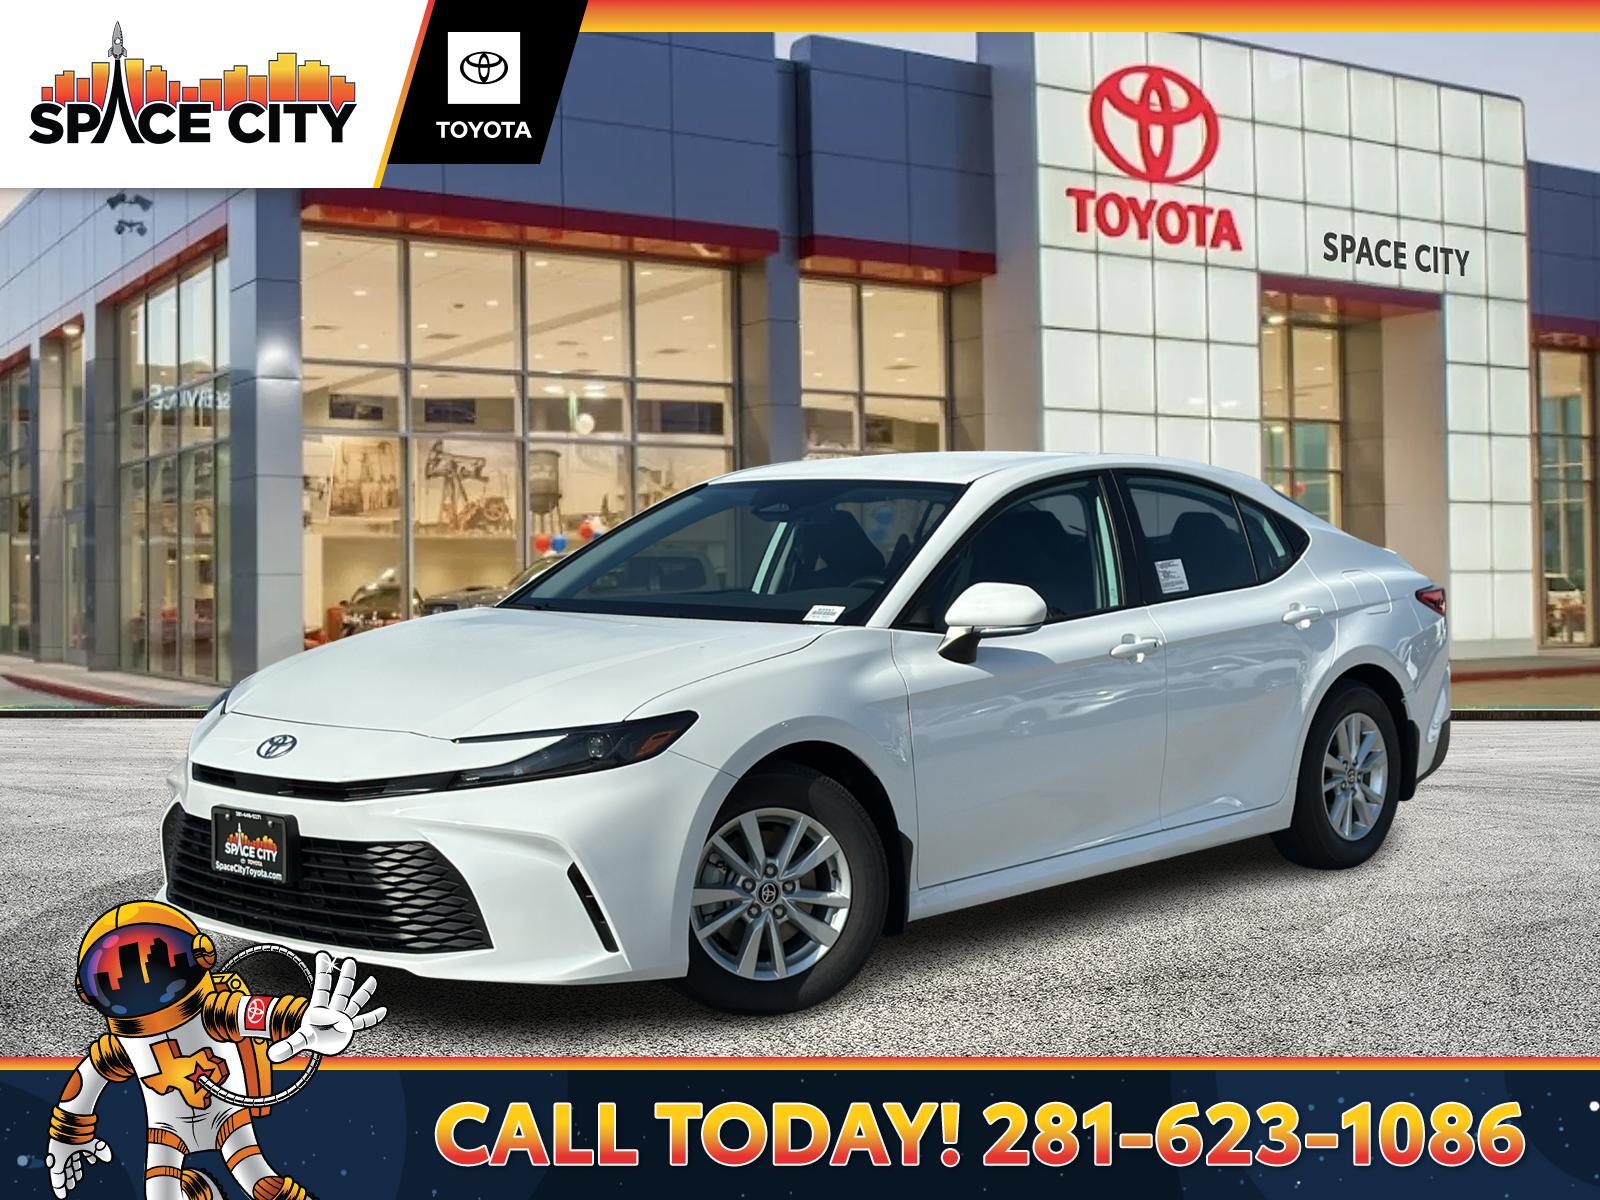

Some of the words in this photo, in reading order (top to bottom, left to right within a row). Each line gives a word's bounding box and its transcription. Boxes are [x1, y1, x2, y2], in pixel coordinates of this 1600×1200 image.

[1065, 187, 1242, 251] TOYOTA
[1323, 231, 1407, 270] SPACE
[1414, 243, 1470, 277] CITY
[225, 841, 255, 857] SPACE
[257, 848, 278, 862] CITY
[215, 861, 282, 880] SpaceCityToyota.com
